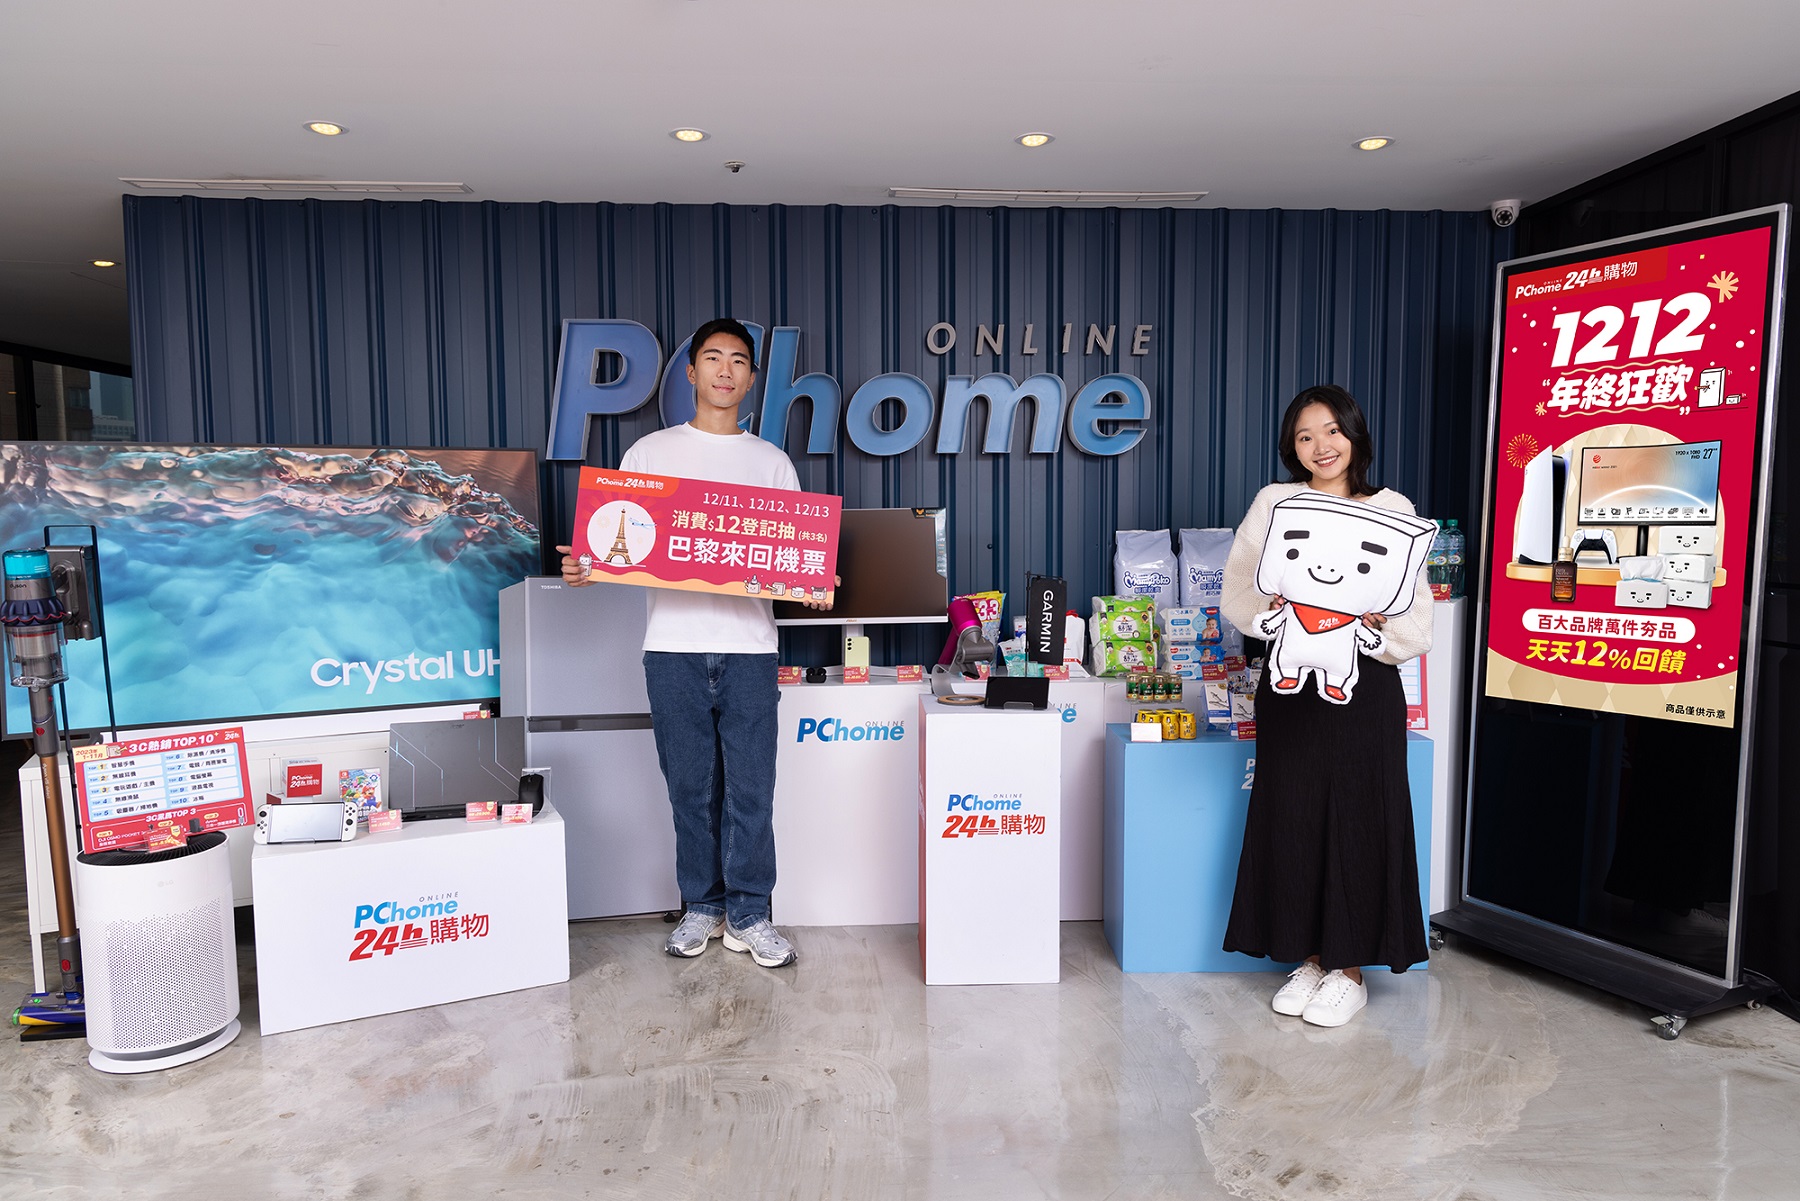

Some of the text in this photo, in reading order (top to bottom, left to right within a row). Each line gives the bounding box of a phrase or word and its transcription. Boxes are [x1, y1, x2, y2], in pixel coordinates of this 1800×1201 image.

[1515, 261, 1638, 298] PChome 24h購物
[927, 322, 1153, 356] ONLINE
[1551, 292, 1712, 368] 1212
[595, 476, 624, 487] PChome
[671, 509, 828, 544] 消費$12登記抽 (共3名)
[667, 535, 827, 576] 巴黎來回機票
[1039, 589, 1054, 653] GARMIN
[1318, 617, 1340, 630] 24h
[1537, 614, 1677, 640] 百大品牌萬件夯品
[310, 650, 454, 695] Crystal
[1525, 638, 1687, 675] 天天12%回饋
[1665, 703, 1726, 720] 商品僅供示意
[796, 717, 905, 743] PChome
[947, 794, 1022, 812] PChome
[941, 814, 1046, 839] 24h購物
[419, 891, 459, 903] ONLINE
[354, 899, 459, 929] PChome
[348, 913, 490, 962] 24h購物
